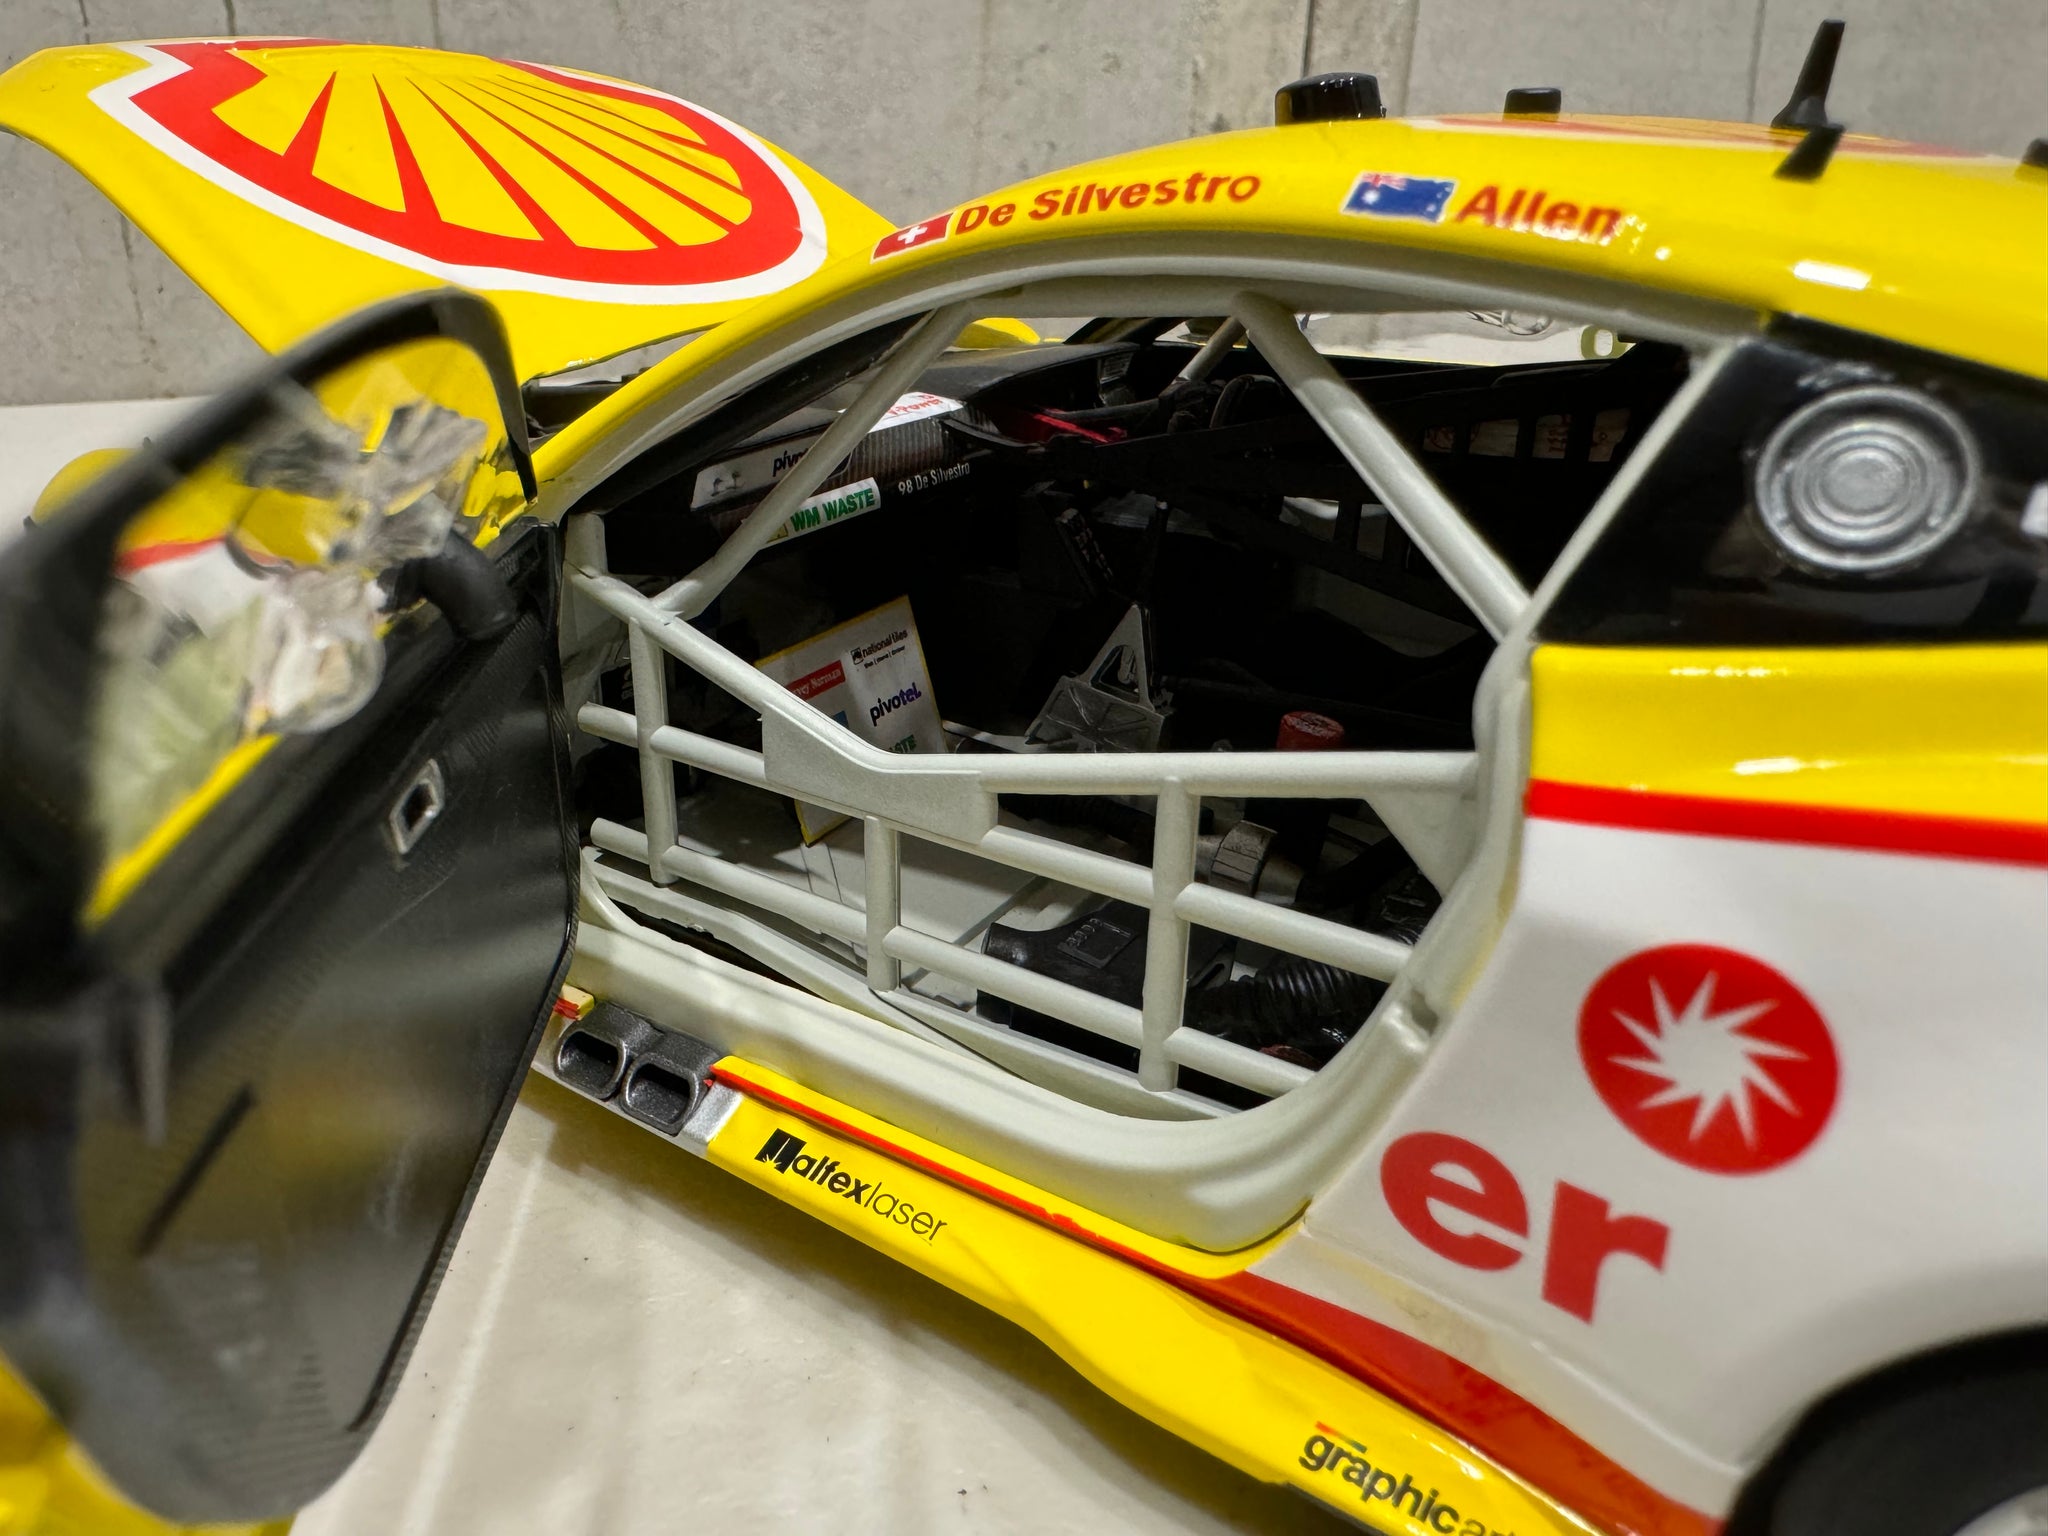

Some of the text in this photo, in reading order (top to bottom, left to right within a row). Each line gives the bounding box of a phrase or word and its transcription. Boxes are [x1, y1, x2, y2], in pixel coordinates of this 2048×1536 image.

[955, 171, 1262, 236] De Silvestro
[1455, 184, 1626, 244] Allen
[898, 462, 971, 496] 98 De Silvestro
[790, 487, 876, 532] WM WASTE
[869, 682, 922, 727] pivotel
[1380, 1131, 1671, 1326] er
